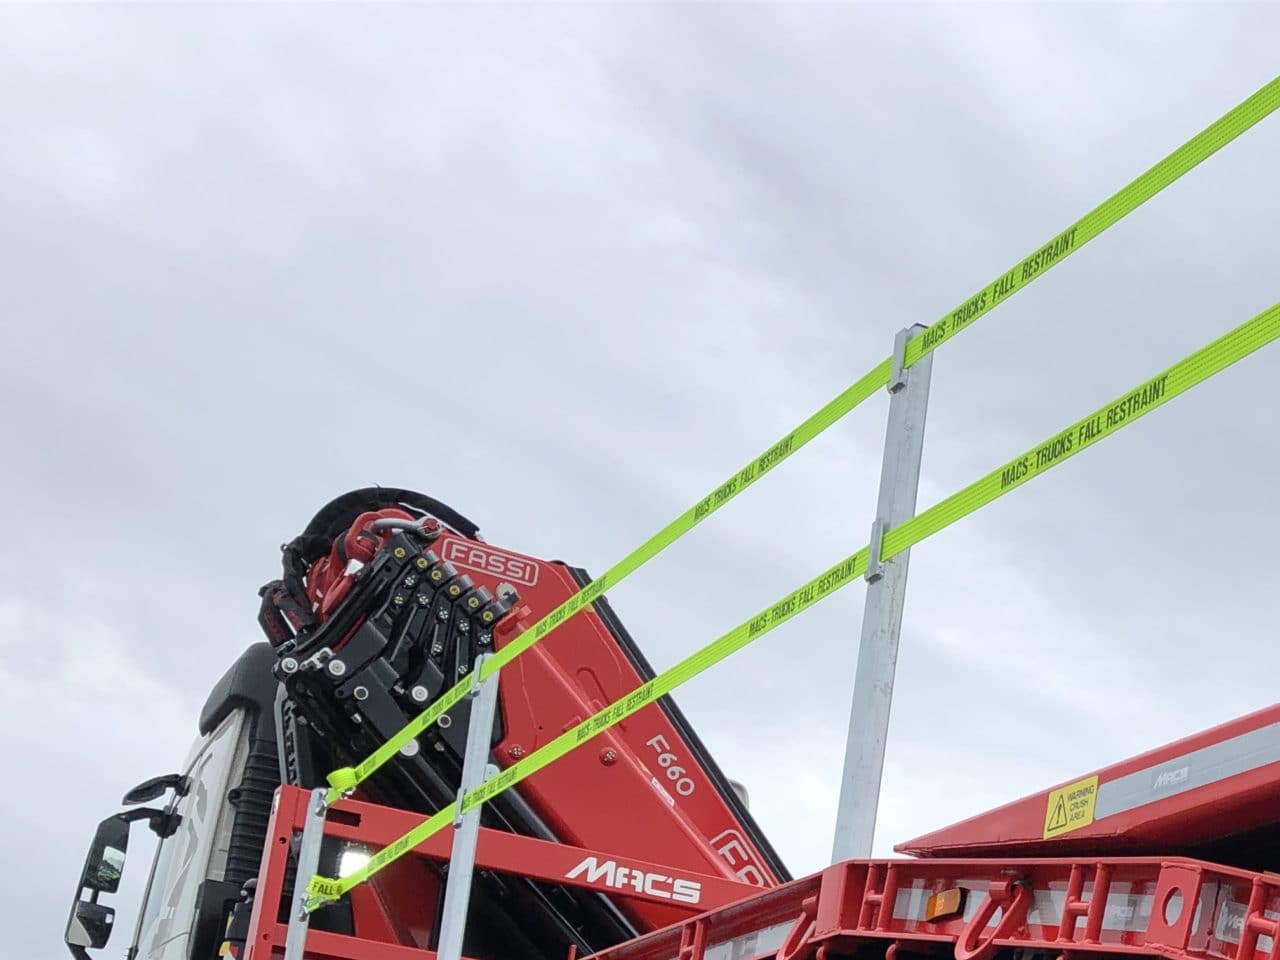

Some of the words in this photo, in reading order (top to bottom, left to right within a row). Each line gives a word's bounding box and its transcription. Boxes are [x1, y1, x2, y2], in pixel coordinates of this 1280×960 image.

[991, 270, 1016, 303] FALL
[1021, 227, 1078, 281] RESTRAINT
[1078, 415, 1103, 447] FALL
[1106, 375, 1169, 429] RESTRAINT
[449, 543, 531, 580] FASSI
[798, 585, 815, 608] FALL
[816, 555, 858, 597] RESTRAINT
[645, 733, 696, 797] F660
[311, 881, 335, 896] FALL
